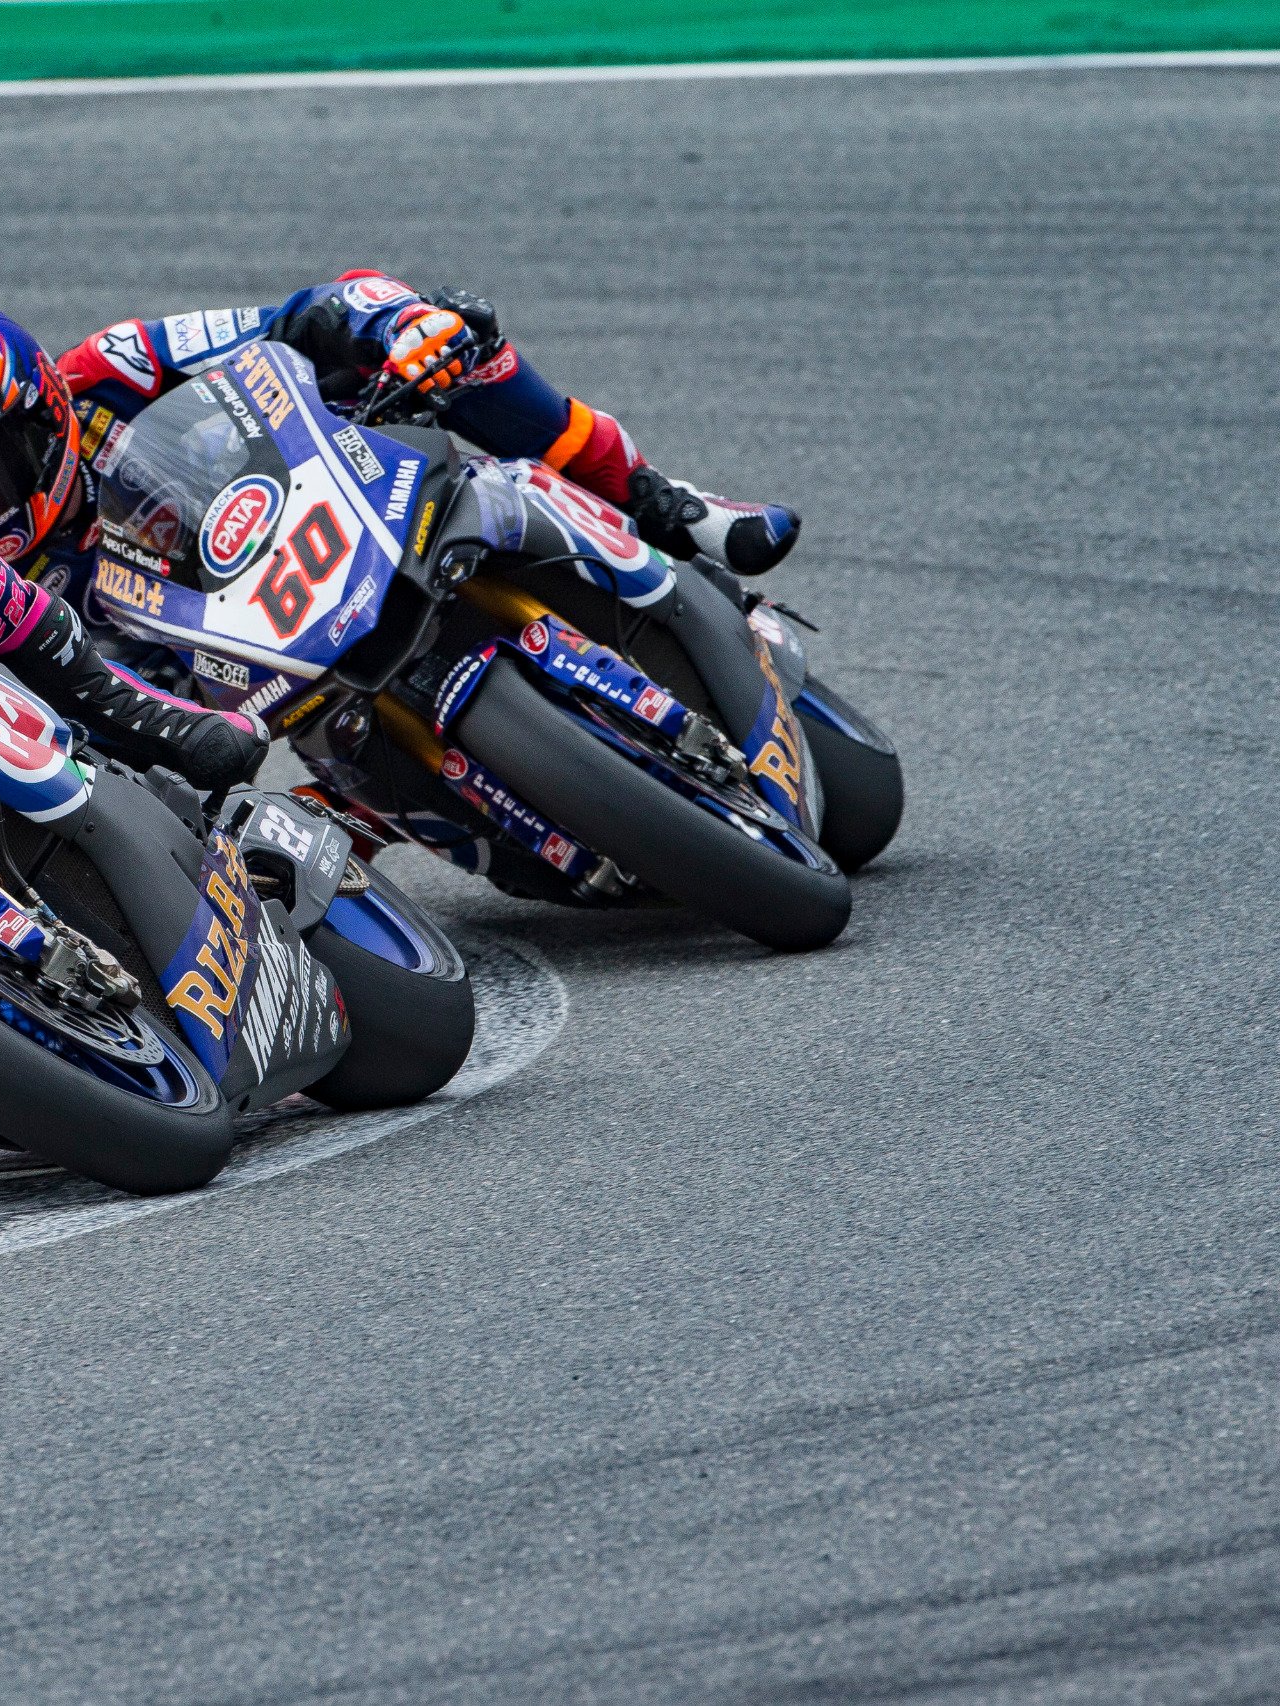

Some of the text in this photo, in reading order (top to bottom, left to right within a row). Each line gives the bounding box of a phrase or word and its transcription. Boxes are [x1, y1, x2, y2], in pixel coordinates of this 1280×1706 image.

[206, 491, 233, 529] SNACK
[385, 459, 419, 521] YAMAHA
[214, 497, 262, 555] PATA
[247, 501, 354, 640] 60
[552, 653, 631, 704] PIRELLI
[259, 805, 314, 862] 22
